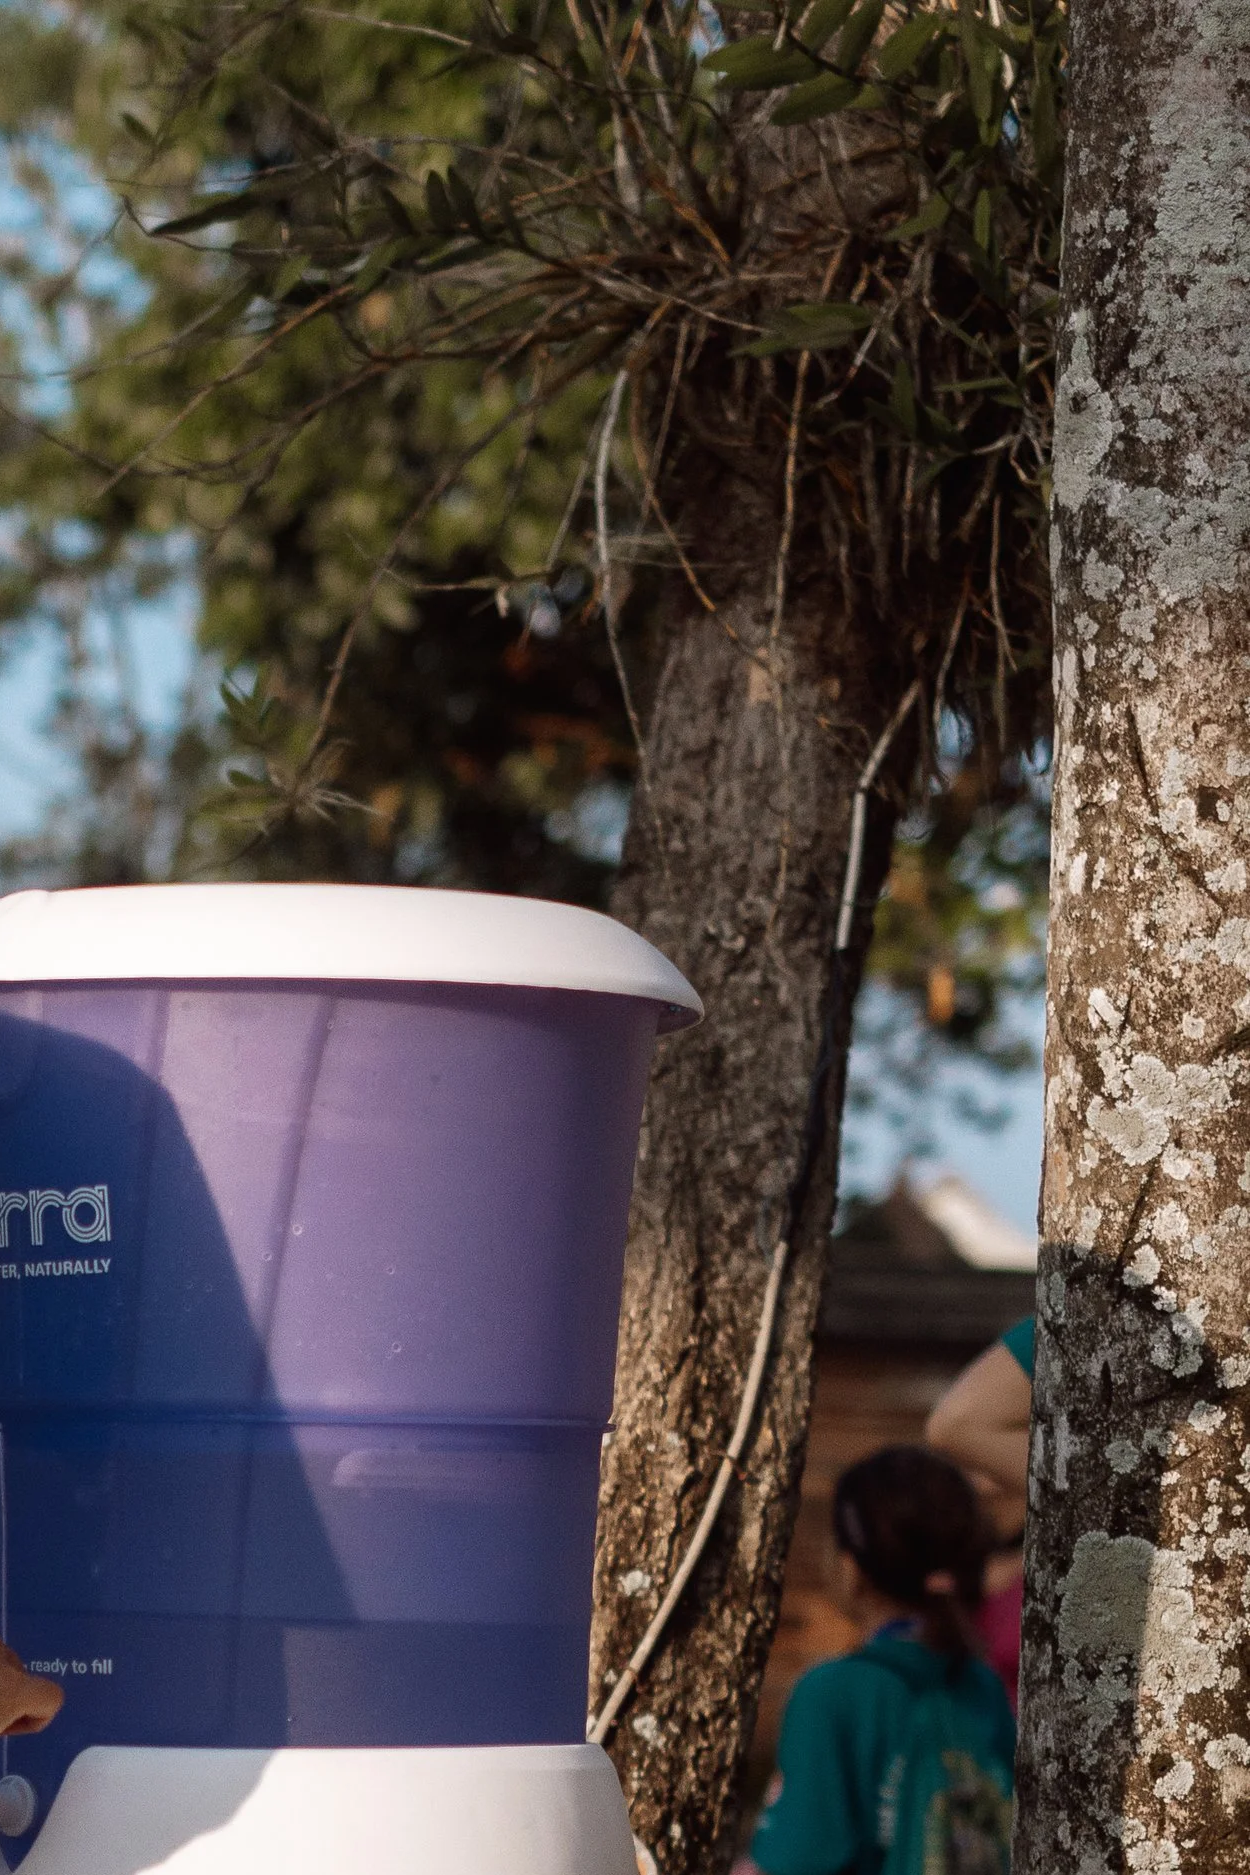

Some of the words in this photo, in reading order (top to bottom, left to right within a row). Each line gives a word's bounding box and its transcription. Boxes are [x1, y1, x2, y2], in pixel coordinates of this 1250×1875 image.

[24, 1258, 111, 1277] NATURALLY
[30, 1658, 68, 1677] ready
[71, 1660, 88, 1674] to
[91, 1658, 113, 1674] fill
